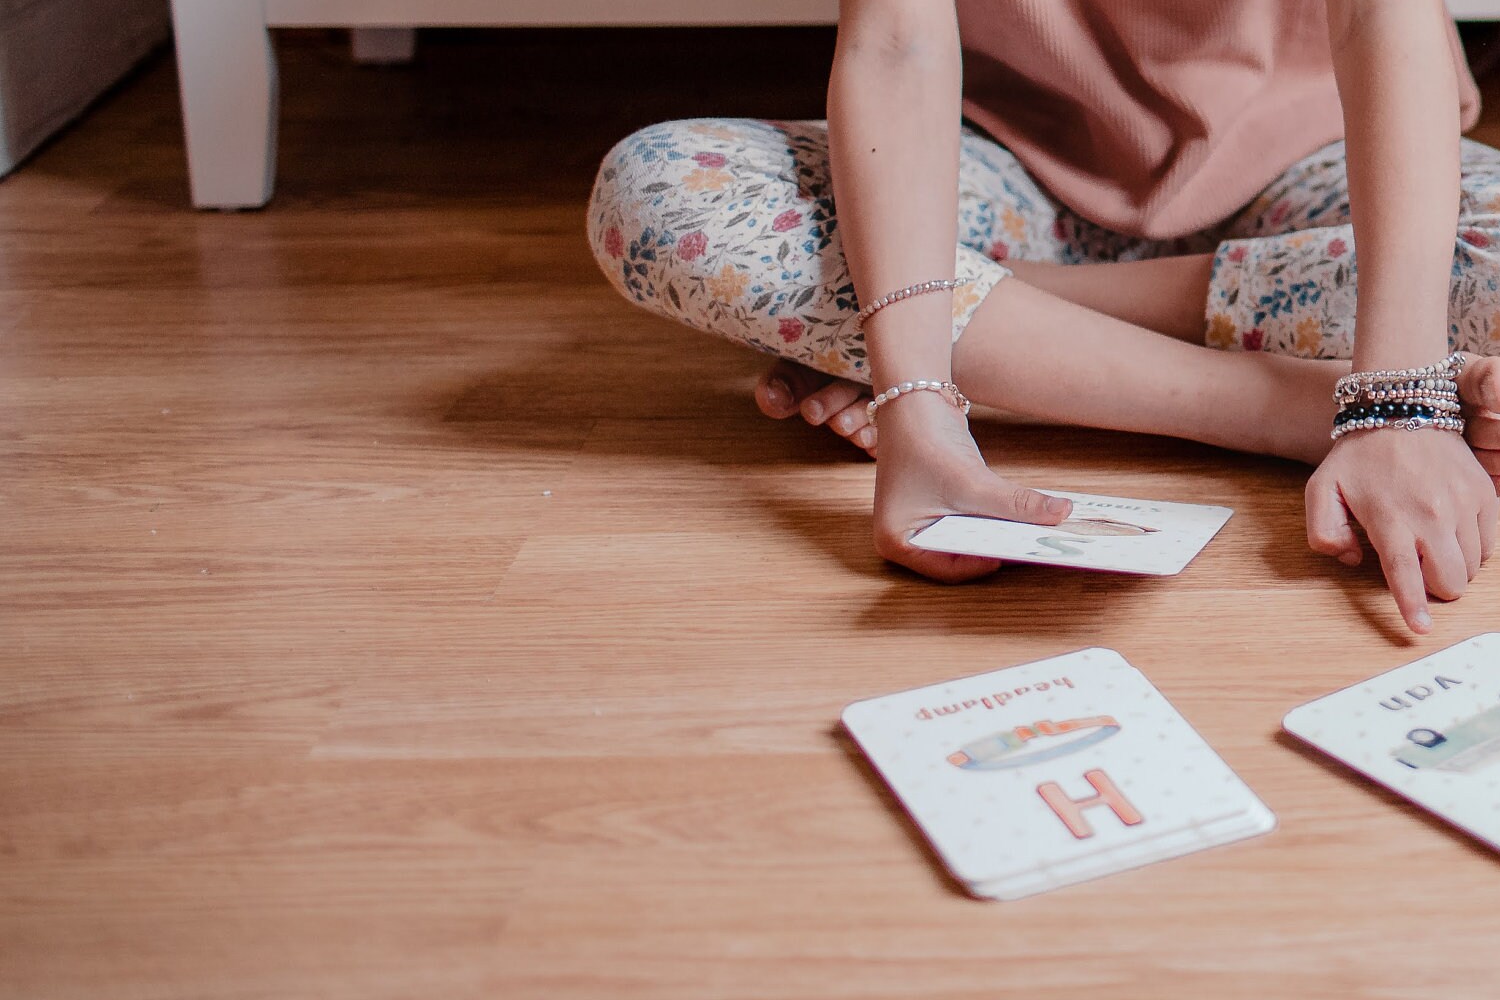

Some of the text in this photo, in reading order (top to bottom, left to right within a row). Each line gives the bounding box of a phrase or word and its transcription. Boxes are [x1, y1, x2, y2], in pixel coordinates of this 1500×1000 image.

[1026, 535, 1096, 558] S
[914, 676, 1076, 721] headlamp
[1379, 674, 1462, 712] van
[1036, 768, 1143, 839] H
